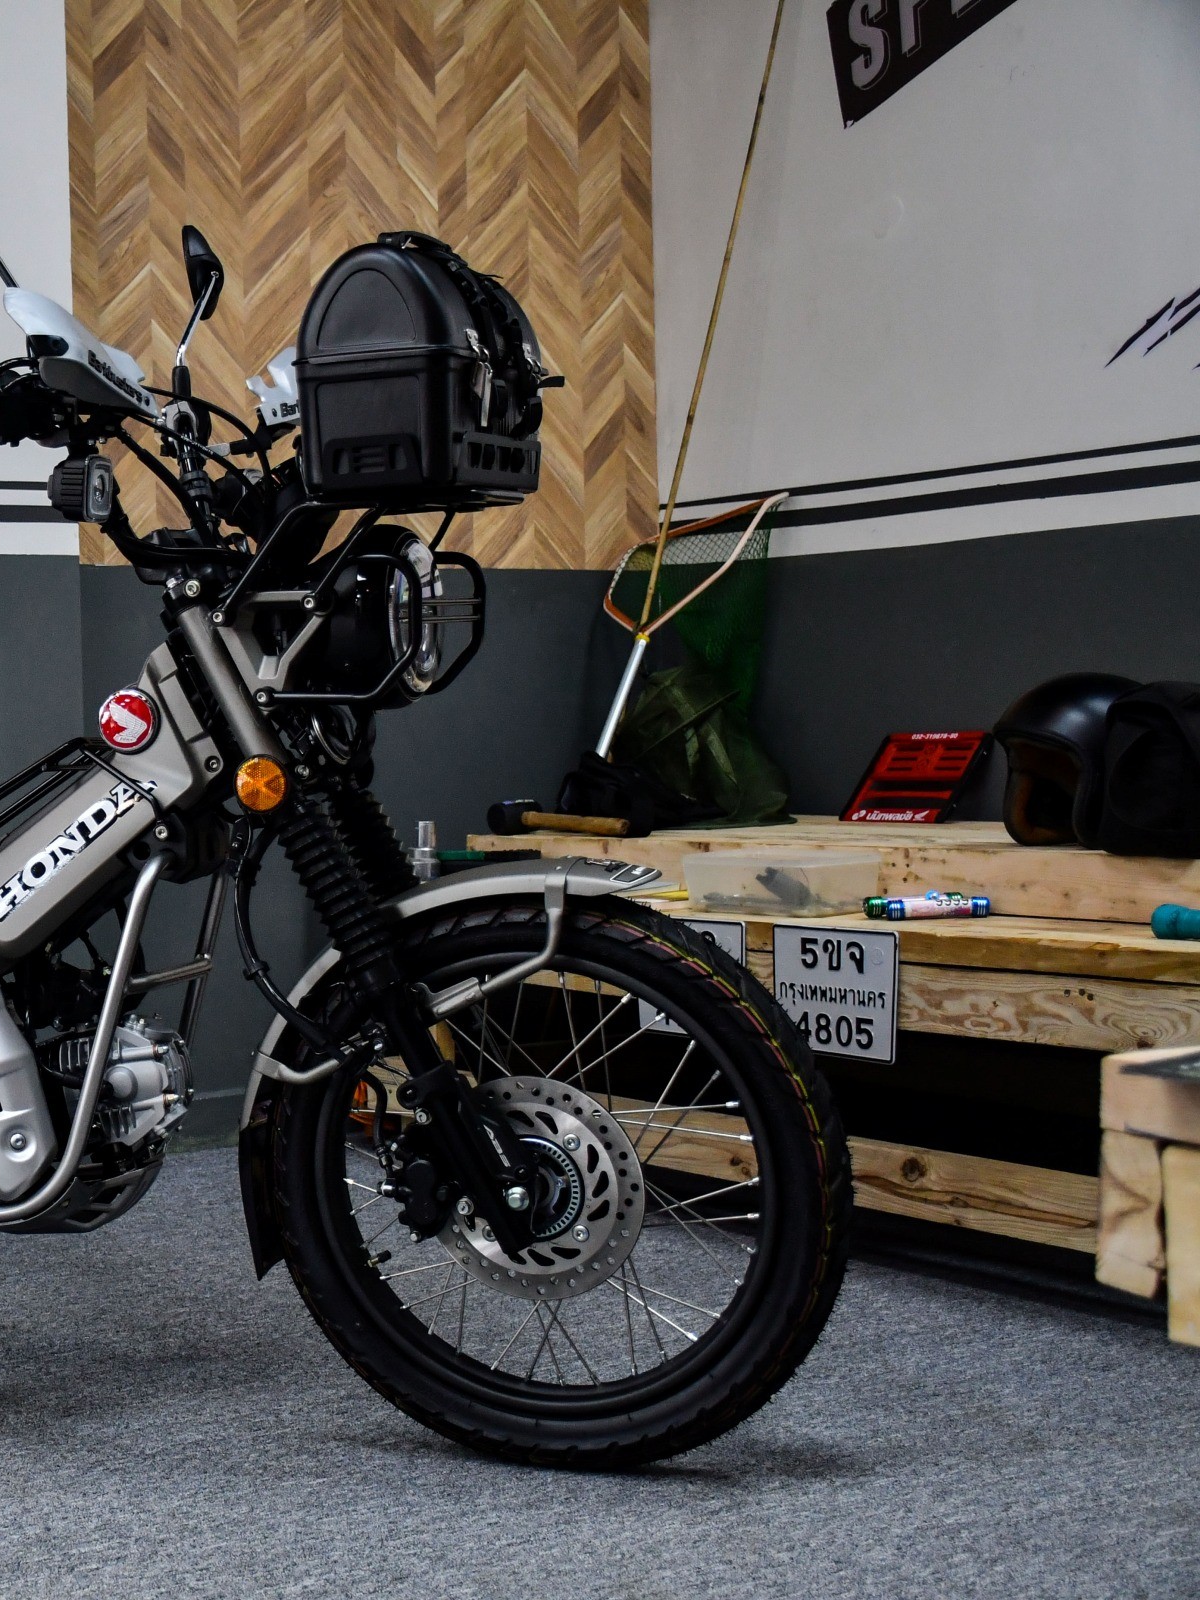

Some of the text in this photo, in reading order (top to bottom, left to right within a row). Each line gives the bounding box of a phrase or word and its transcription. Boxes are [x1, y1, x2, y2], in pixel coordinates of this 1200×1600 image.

[800, 937, 865, 974] 5ขจ
[779, 981, 887, 1009] กรุงเทพมหานคร
[796, 1010, 875, 1050] 4805
